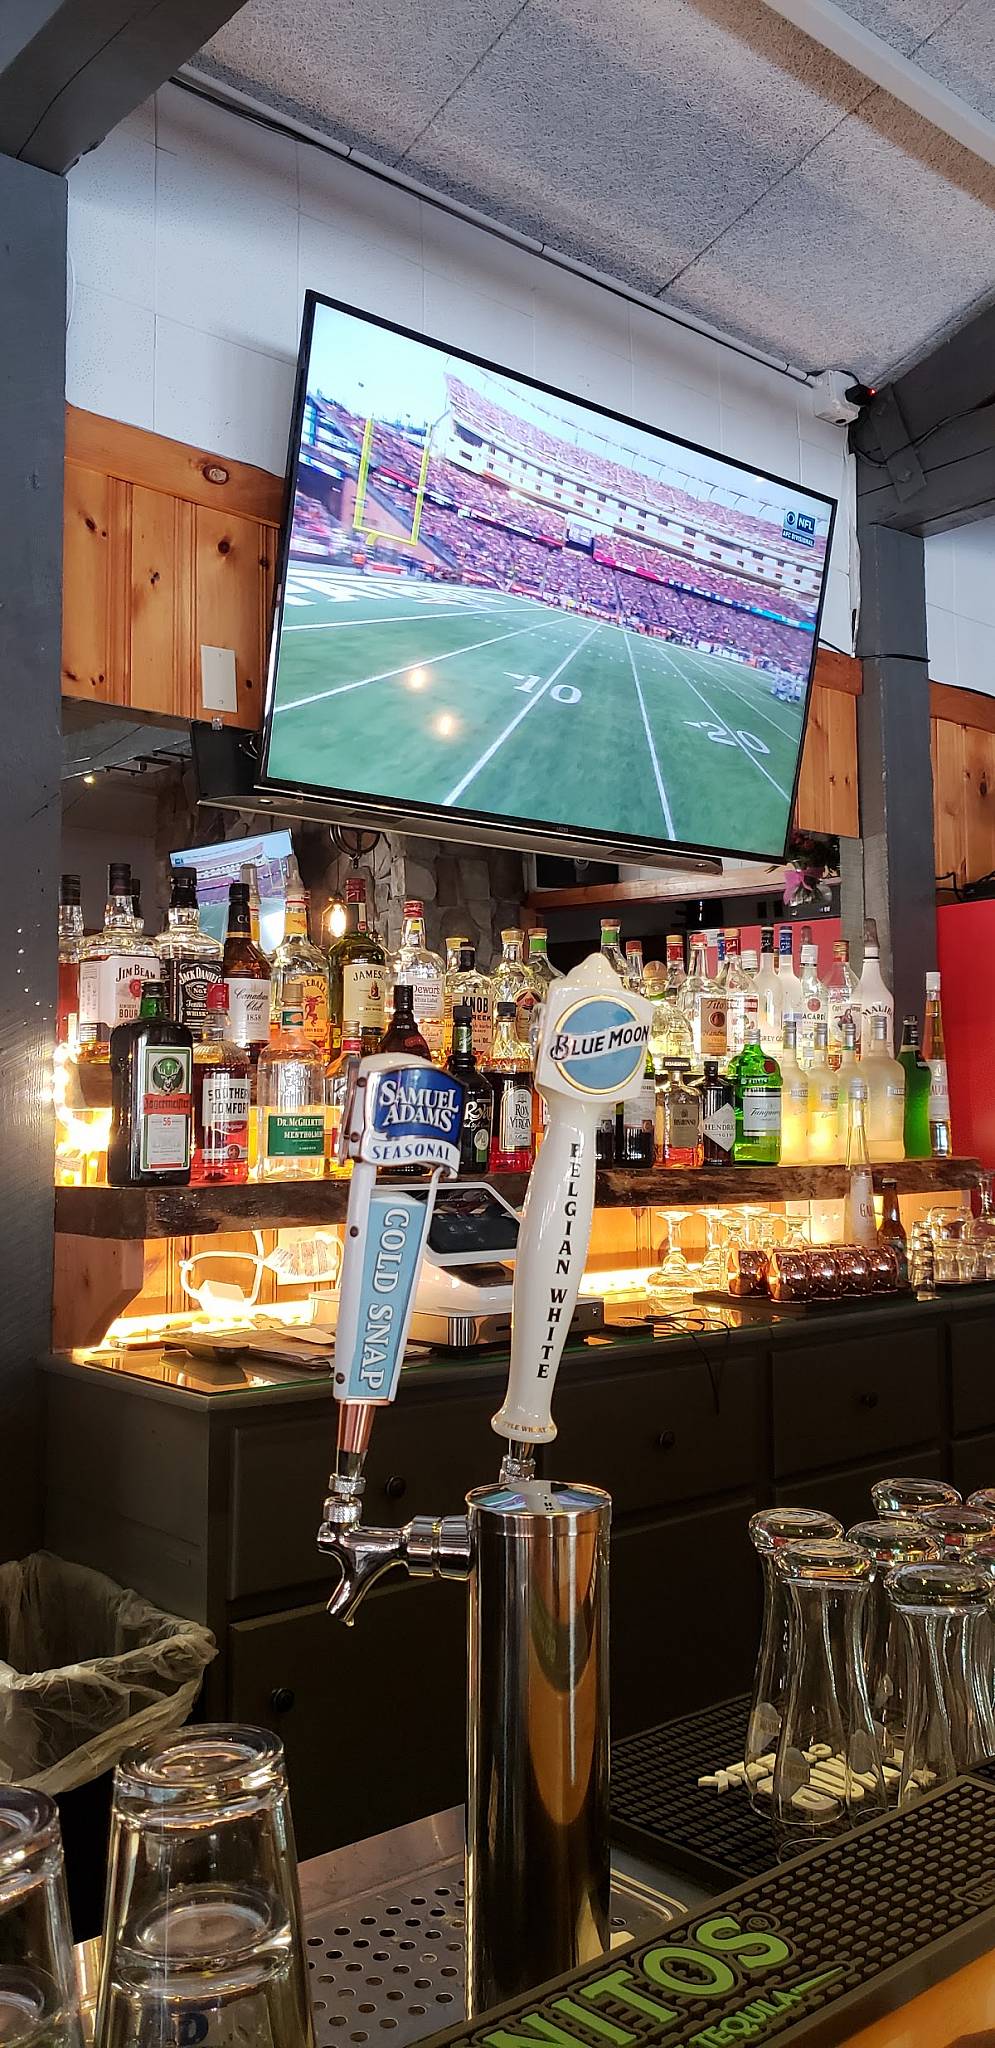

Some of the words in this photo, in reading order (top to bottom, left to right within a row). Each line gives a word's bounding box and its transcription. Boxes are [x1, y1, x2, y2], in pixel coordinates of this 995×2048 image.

[798, 517, 814, 531] NFL
[115, 967, 133, 982] JIM
[178, 970, 196, 985] JACK
[462, 996, 489, 1014] KNOB
[550, 1035, 605, 1061] BLUE
[607, 1025, 650, 1050] MOON
[379, 1080, 460, 1113] SAMUEL
[163, 1117, 172, 1126] 56
[382, 1104, 453, 1133] ADAMS
[372, 1143, 451, 1161] SEASONAL
[373, 1207, 411, 1295] COLD
[536, 1288, 568, 1379] WHITE
[358, 1303, 394, 1391] SNAP
